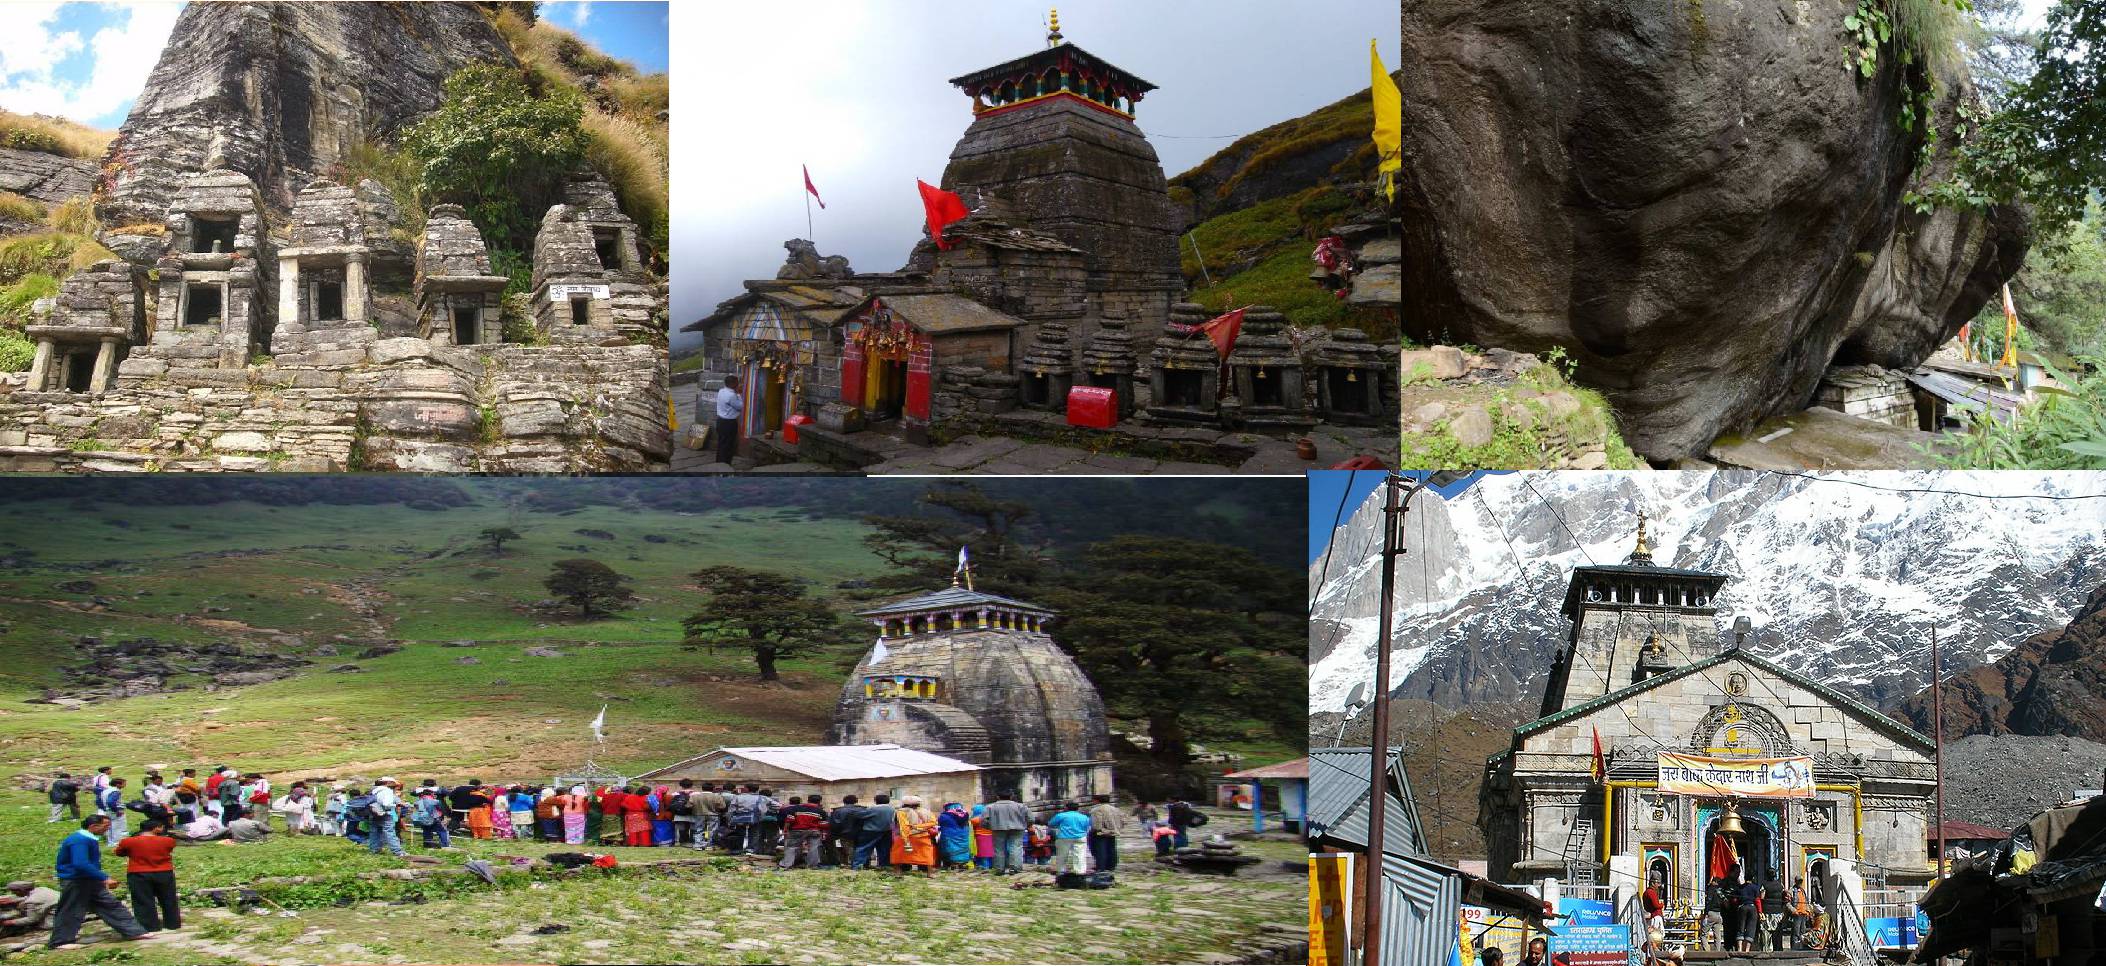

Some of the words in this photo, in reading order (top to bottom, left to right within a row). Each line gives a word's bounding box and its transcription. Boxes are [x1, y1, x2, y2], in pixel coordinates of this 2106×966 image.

[1661, 766, 1680, 780] जय
[1705, 762, 1733, 785] केदार
[1734, 769, 1754, 785] नाथ
[1756, 763, 1769, 785] जी
